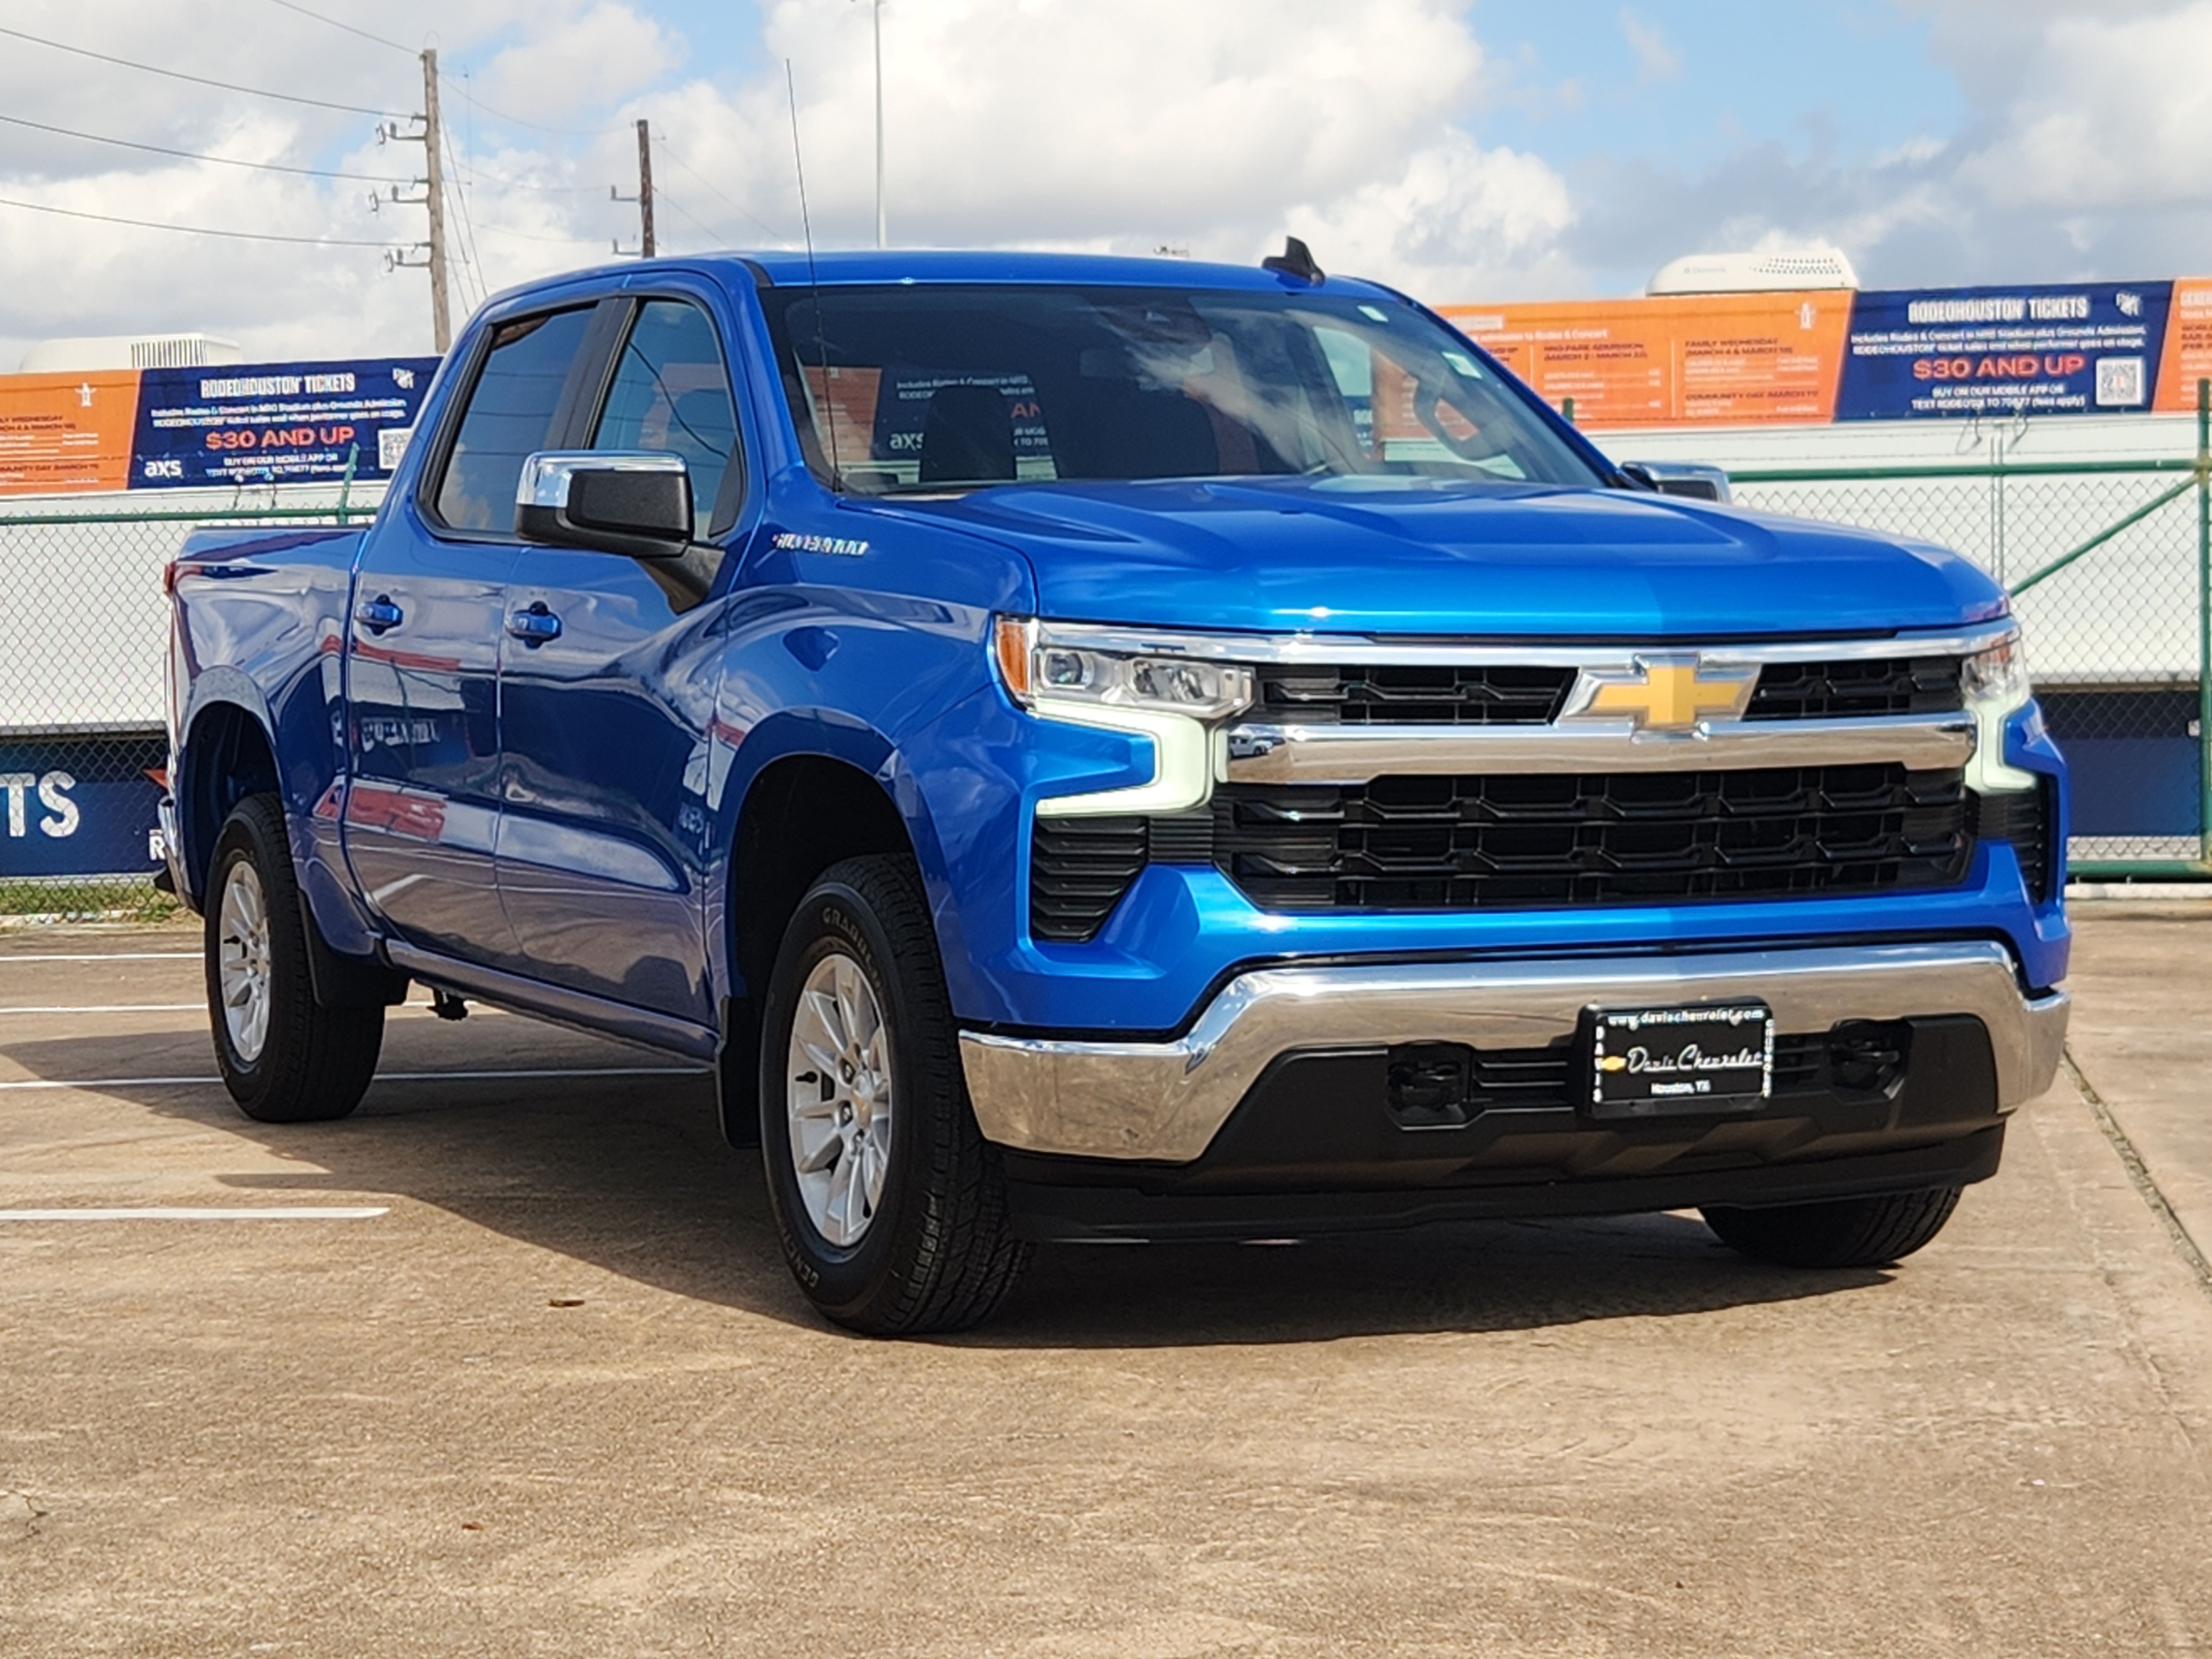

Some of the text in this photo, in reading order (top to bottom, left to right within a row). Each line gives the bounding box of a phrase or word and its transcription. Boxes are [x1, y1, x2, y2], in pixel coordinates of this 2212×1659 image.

[2028, 295, 2089, 320] TICKETS
[1912, 354, 2085, 380] $30 AND UP
[304, 372, 355, 394] TICKETS
[205, 426, 355, 450] $30 AND UP
[144, 460, 182, 478] axs
[0, 770, 79, 837] TS
[1676, 1043, 1763, 1071] Chevrolet
